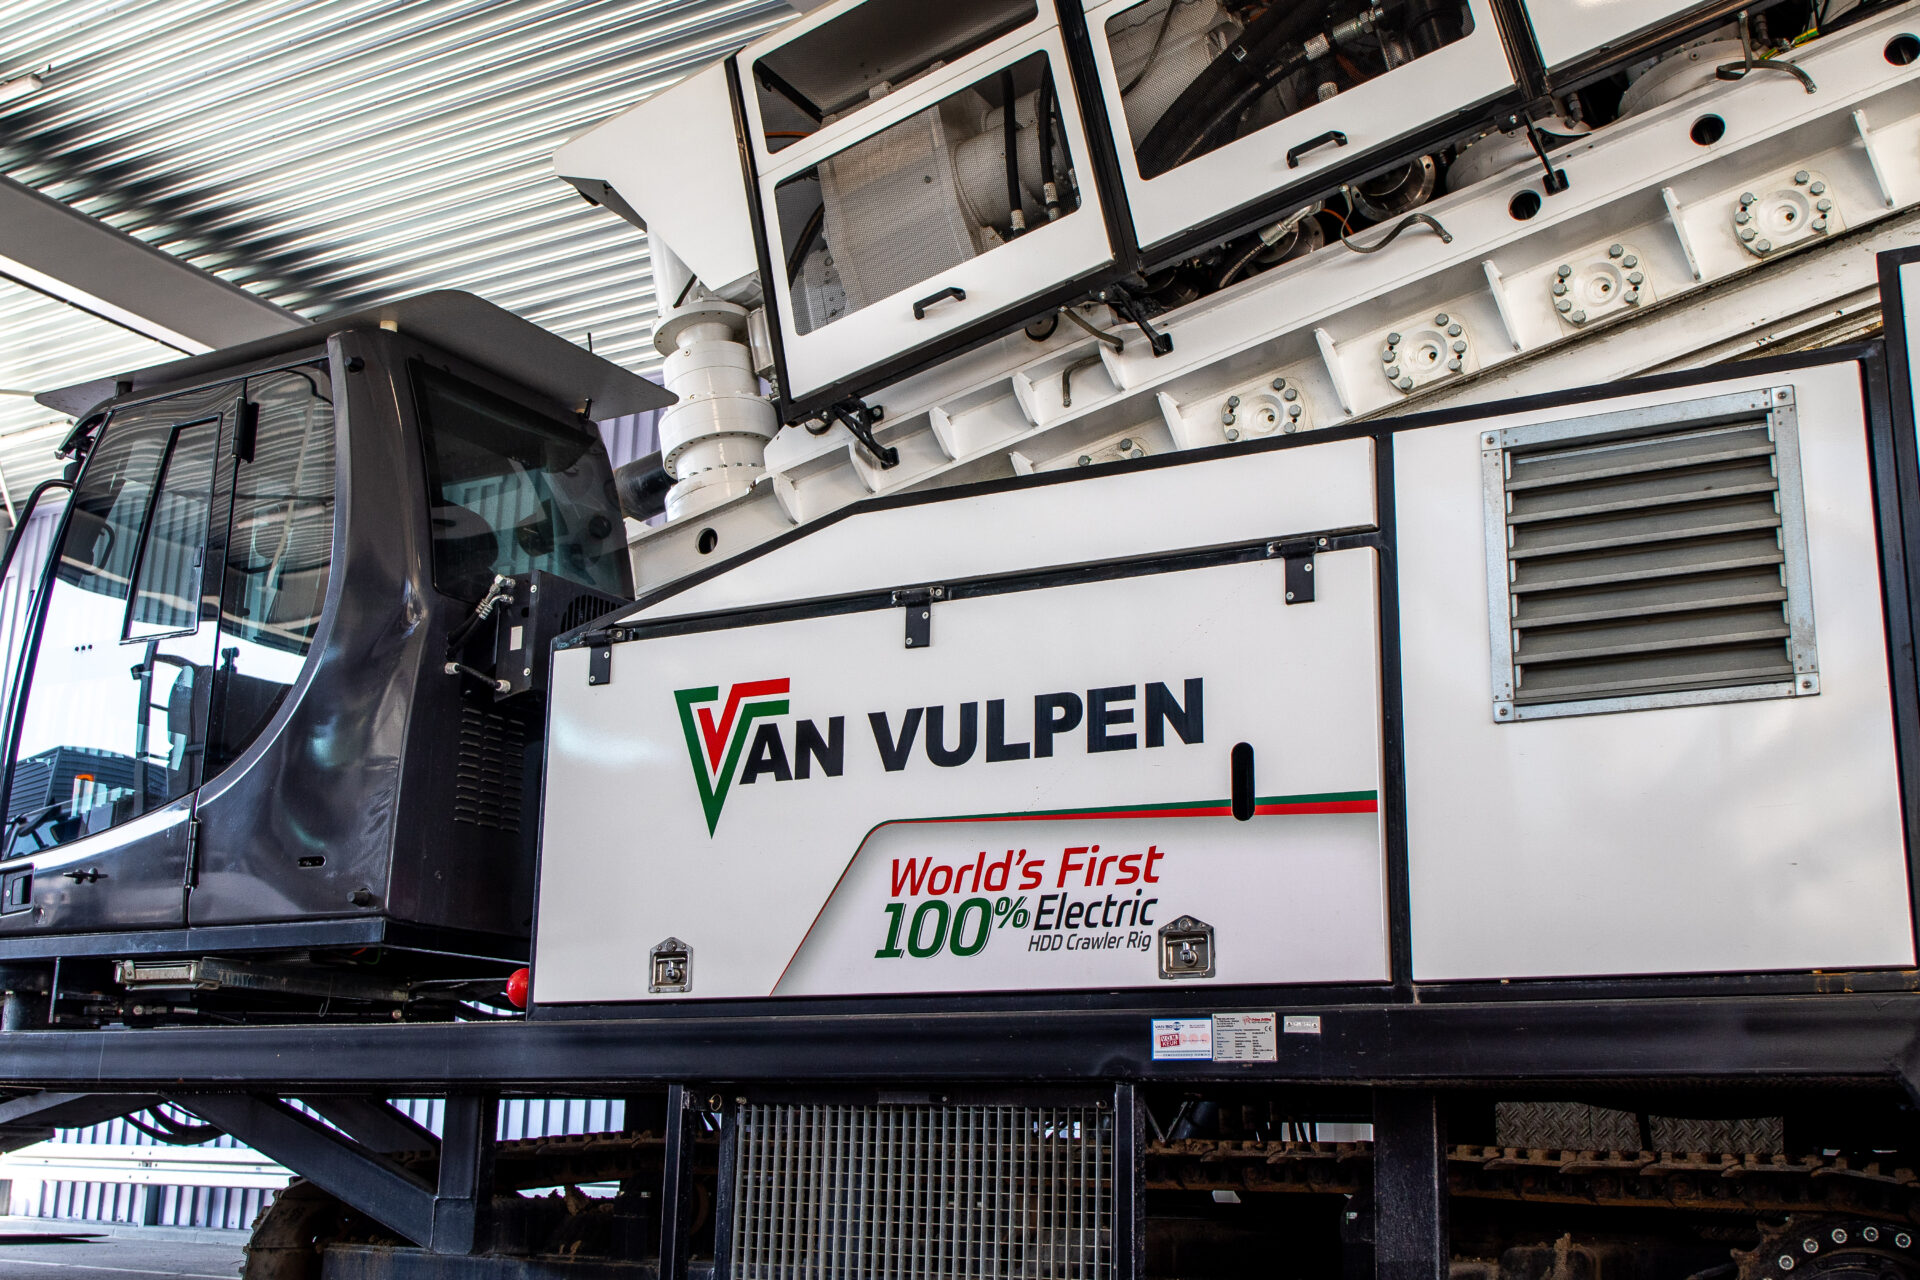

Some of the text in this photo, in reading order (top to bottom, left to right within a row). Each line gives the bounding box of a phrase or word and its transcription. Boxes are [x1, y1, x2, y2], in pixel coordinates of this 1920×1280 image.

[674, 678, 1204, 838] VAN VULPEN
[892, 845, 1165, 897] World's First
[874, 889, 1158, 959] 100% Electric
[1028, 931, 1152, 952] HDD Crawler Rig
